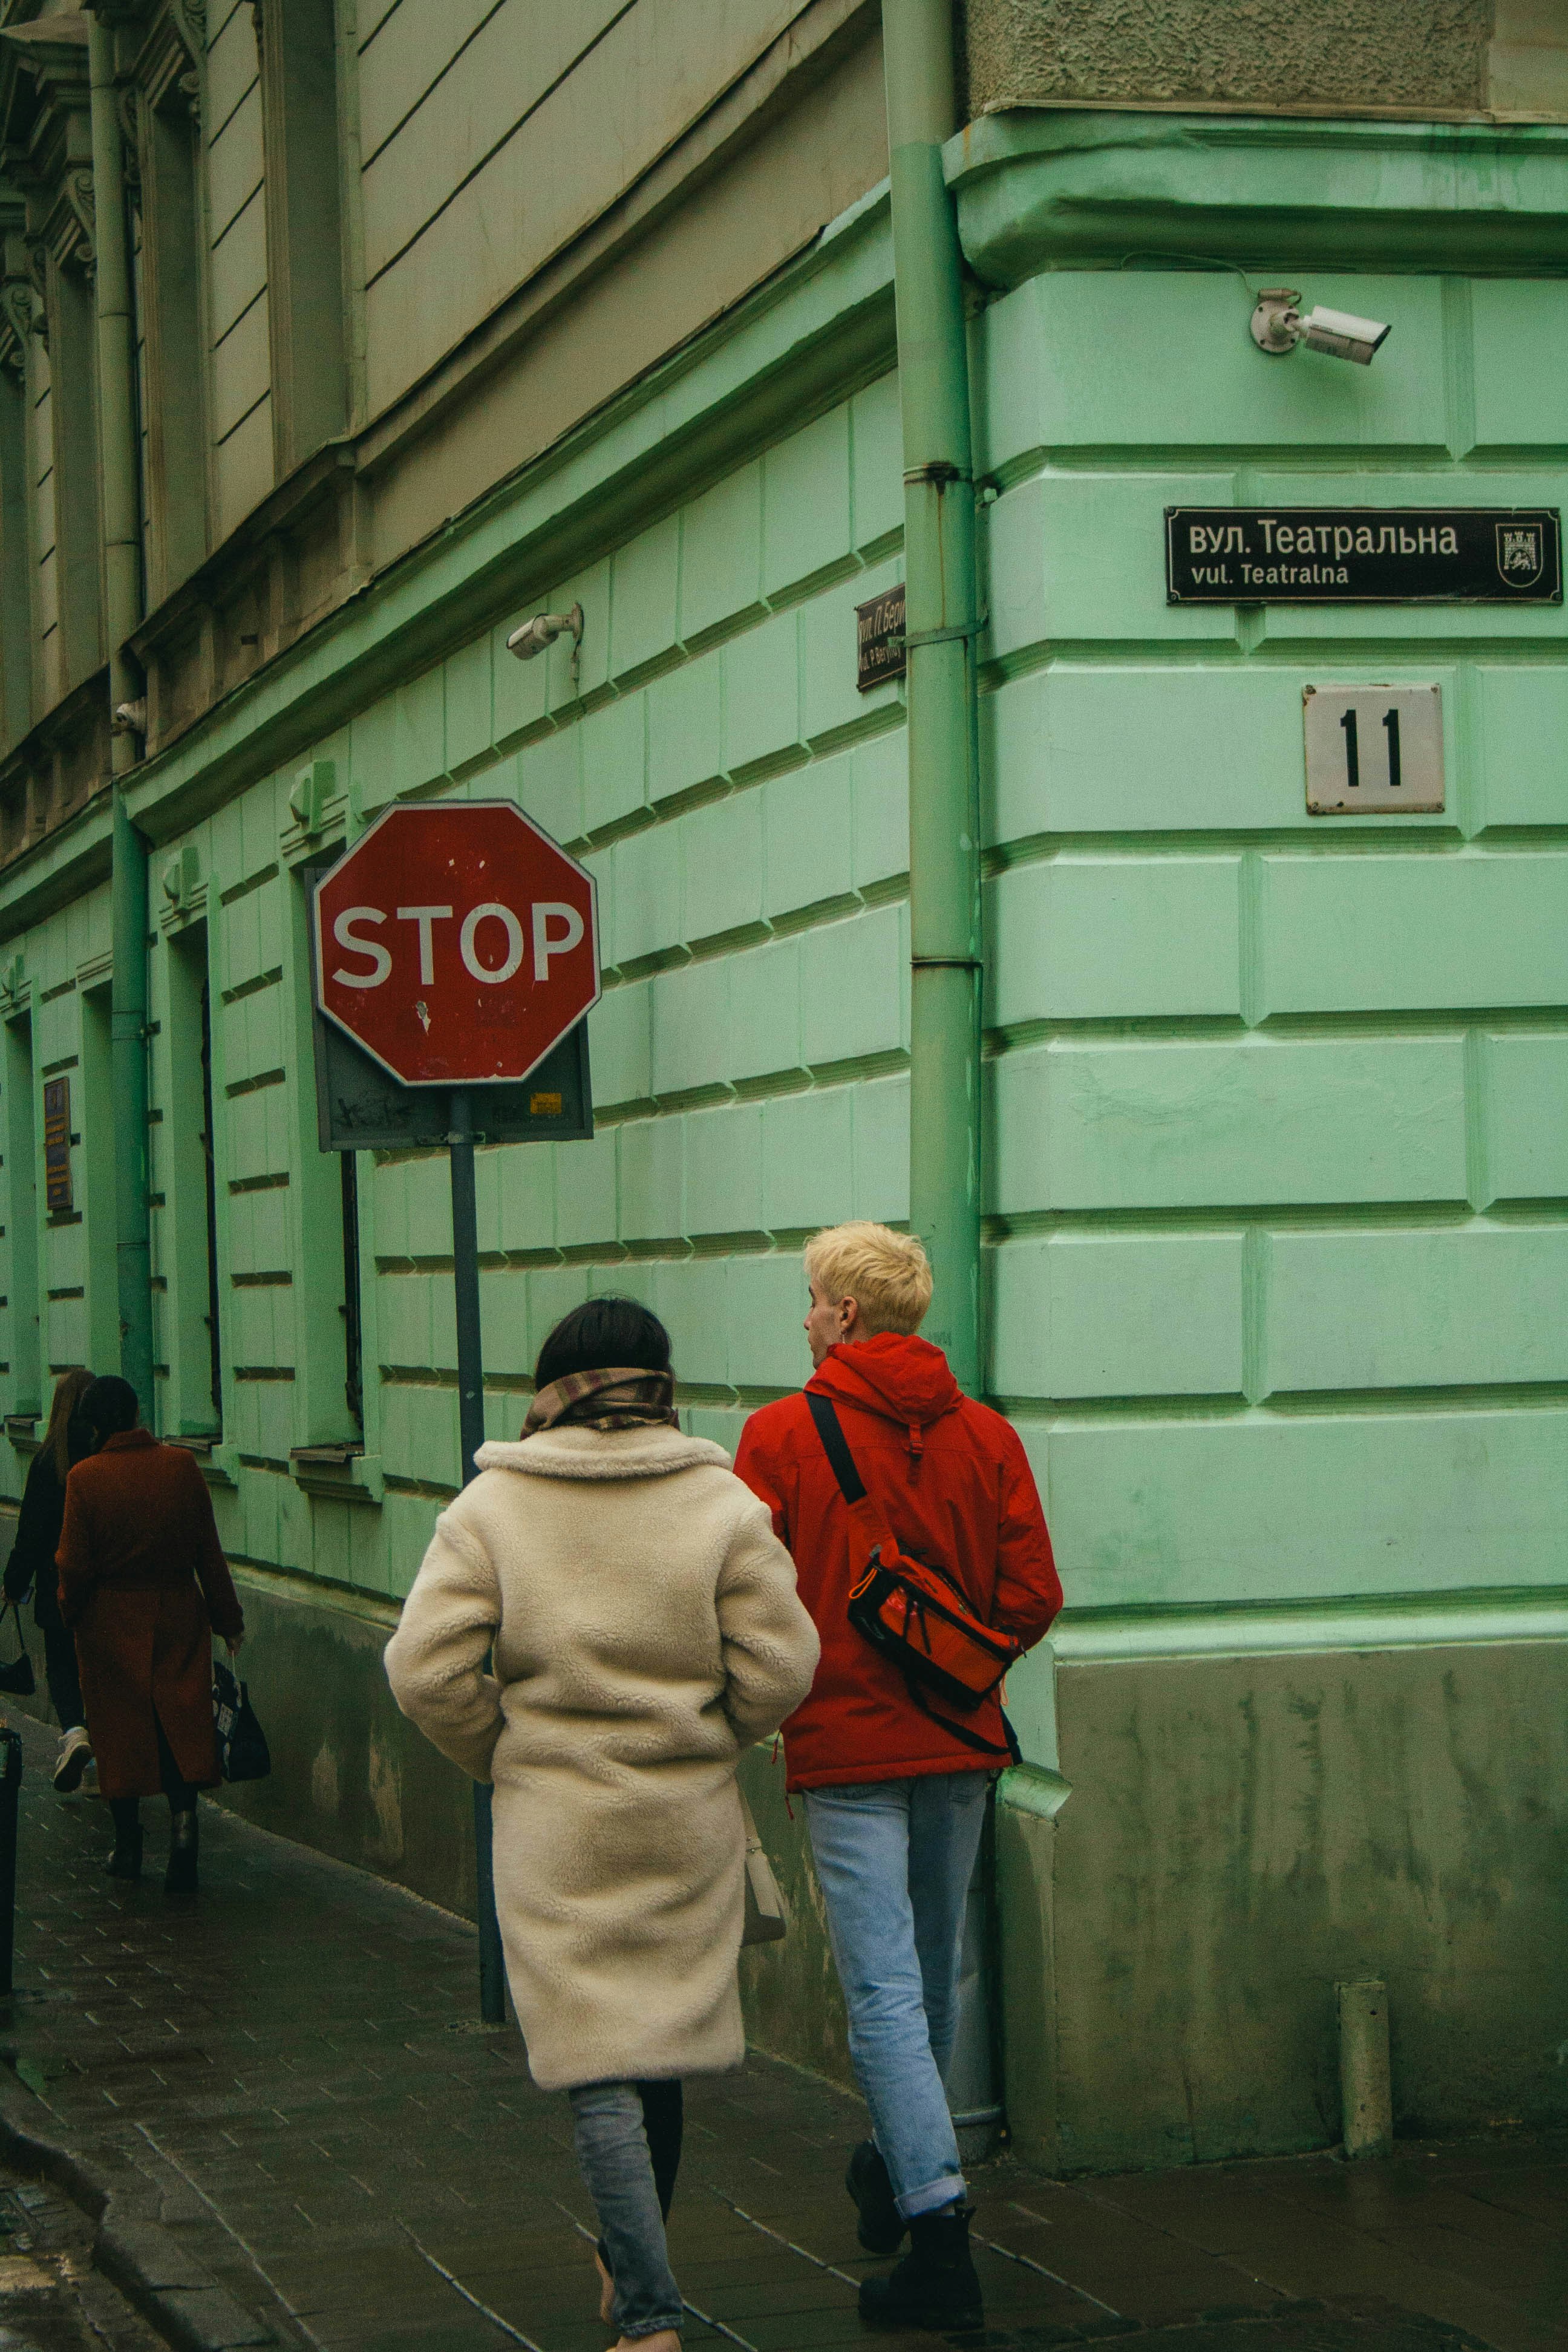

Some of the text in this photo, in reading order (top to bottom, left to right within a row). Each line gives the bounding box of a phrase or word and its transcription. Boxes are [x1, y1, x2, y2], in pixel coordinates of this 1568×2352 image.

[1189, 519, 1459, 560] вул. Театральна
[1191, 563, 1349, 584] vul. Teatralna
[1339, 709, 1402, 786] 11
[332, 902, 584, 988] STOP
